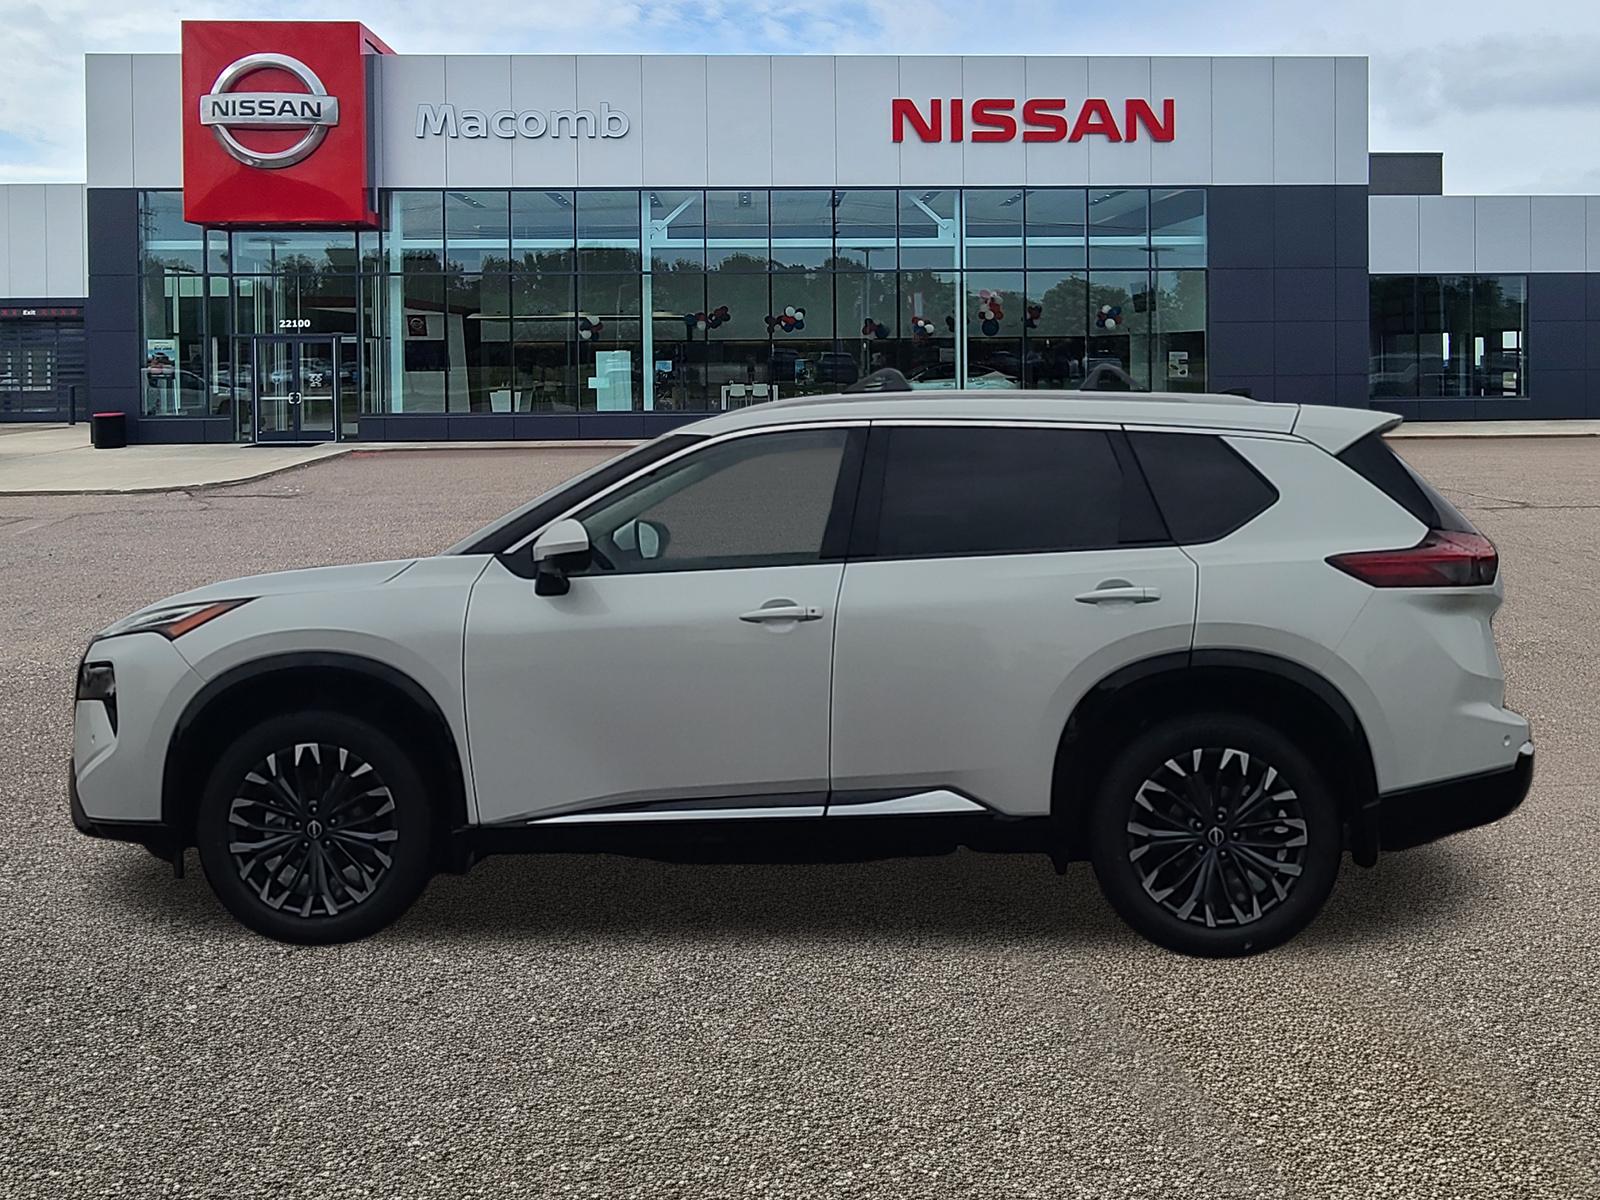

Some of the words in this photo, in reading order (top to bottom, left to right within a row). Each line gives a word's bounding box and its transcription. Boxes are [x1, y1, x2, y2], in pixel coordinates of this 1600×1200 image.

[211, 100, 322, 118] NISSAN
[415, 101, 630, 139] Macomb
[892, 98, 1175, 143] NISSAN
[279, 319, 311, 328] 22100
